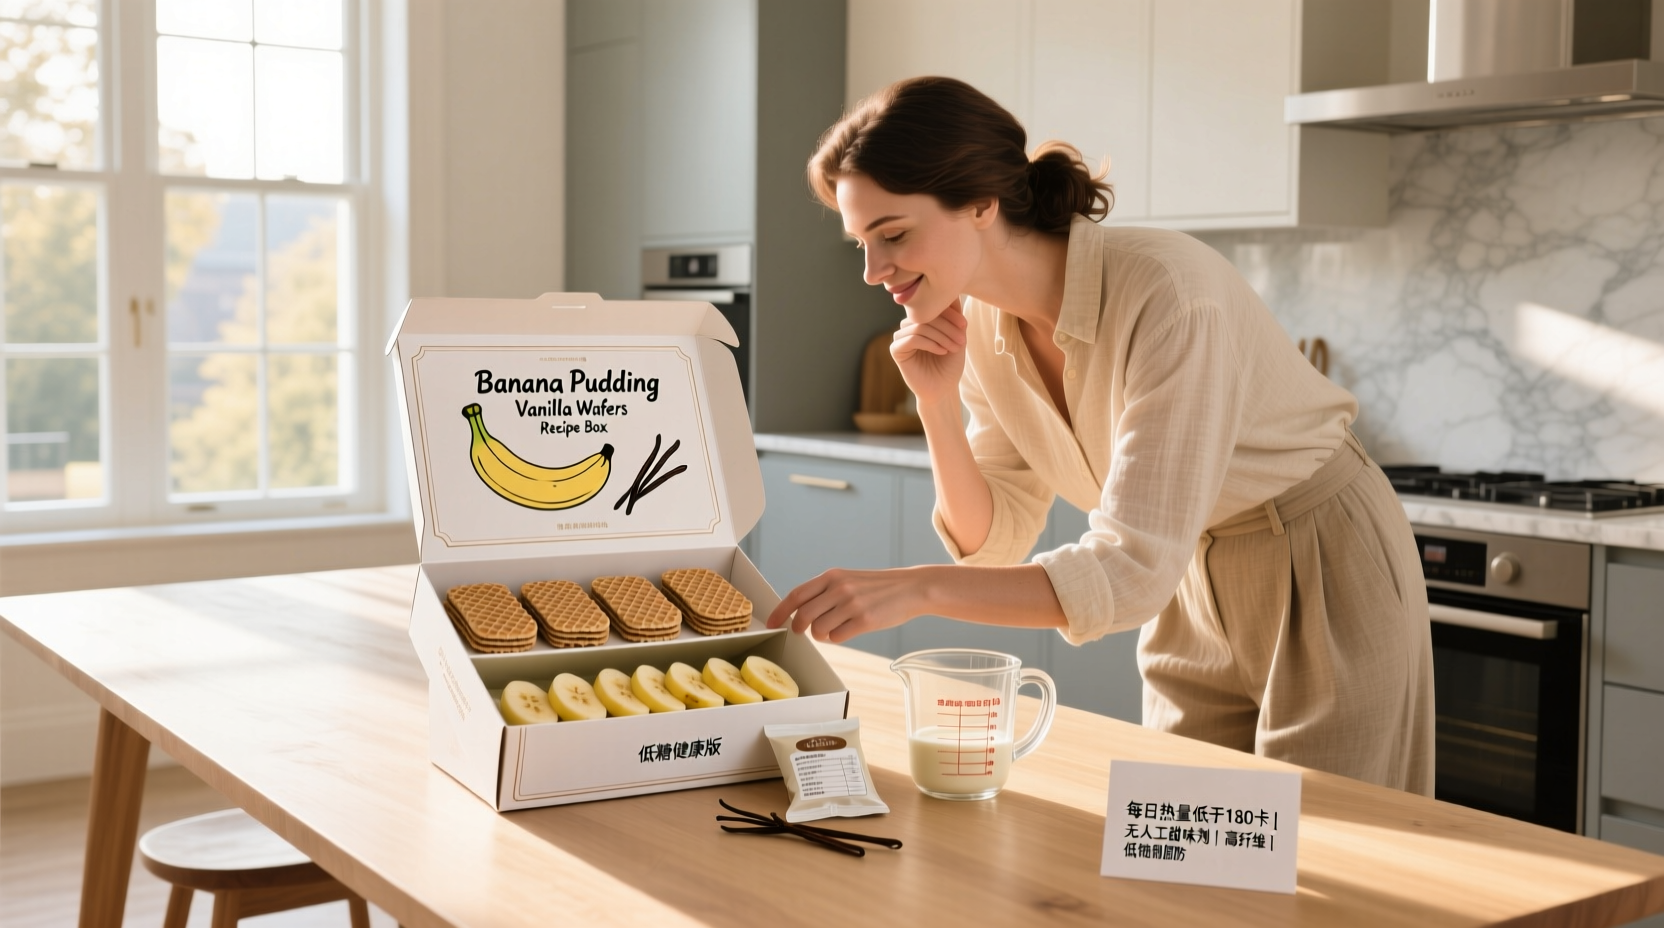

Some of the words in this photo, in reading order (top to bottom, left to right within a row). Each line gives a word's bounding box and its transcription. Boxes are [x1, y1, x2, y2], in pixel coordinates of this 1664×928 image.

[474, 369, 564, 395] Banana
[570, 368, 660, 402] Pudding
[515, 399, 572, 418] Vanilla
[576, 398, 628, 417] Wafers
[540, 421, 581, 438] Recipe
[584, 420, 608, 434] Box
[638, 736, 723, 764] 低糖健康版
